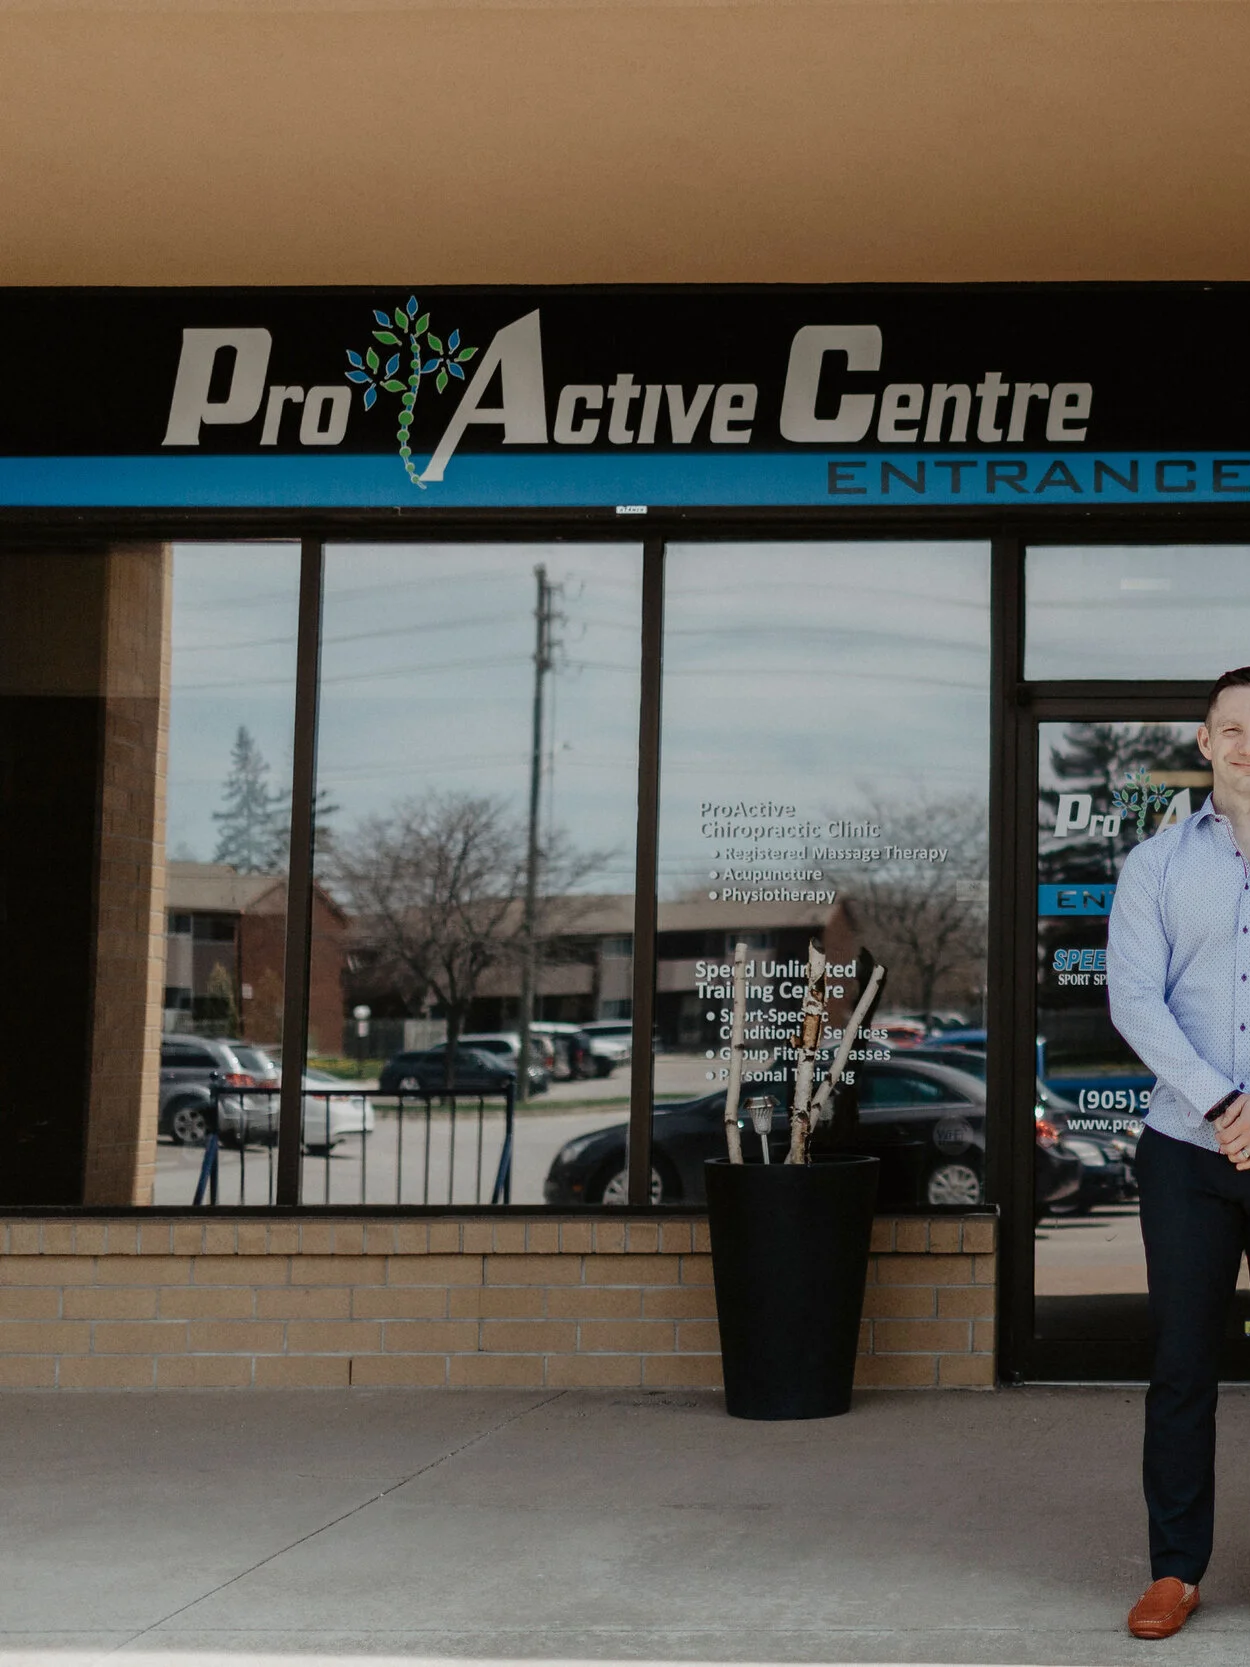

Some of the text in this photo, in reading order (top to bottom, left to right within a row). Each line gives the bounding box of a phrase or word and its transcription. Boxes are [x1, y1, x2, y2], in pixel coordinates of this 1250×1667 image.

[780, 324, 1093, 443] Centre
[700, 801, 796, 818] ProActive
[700, 821, 882, 842] Chiropractic Clinic
[725, 845, 948, 863] Registered Massage Therapy
[723, 868, 824, 884] Acupuncture
[722, 887, 836, 904] Physiotherapy
[1053, 948, 1106, 971] SPEE
[695, 960, 857, 981] Sped Unlited
[1058, 973, 1090, 986] SPORT
[695, 981, 844, 1003] Traiing Cere
[720, 1025, 888, 1040] Cnditioni Seices
[773, 1046, 829, 1061] Fitss
[720, 1067, 787, 1082] Prsonal
